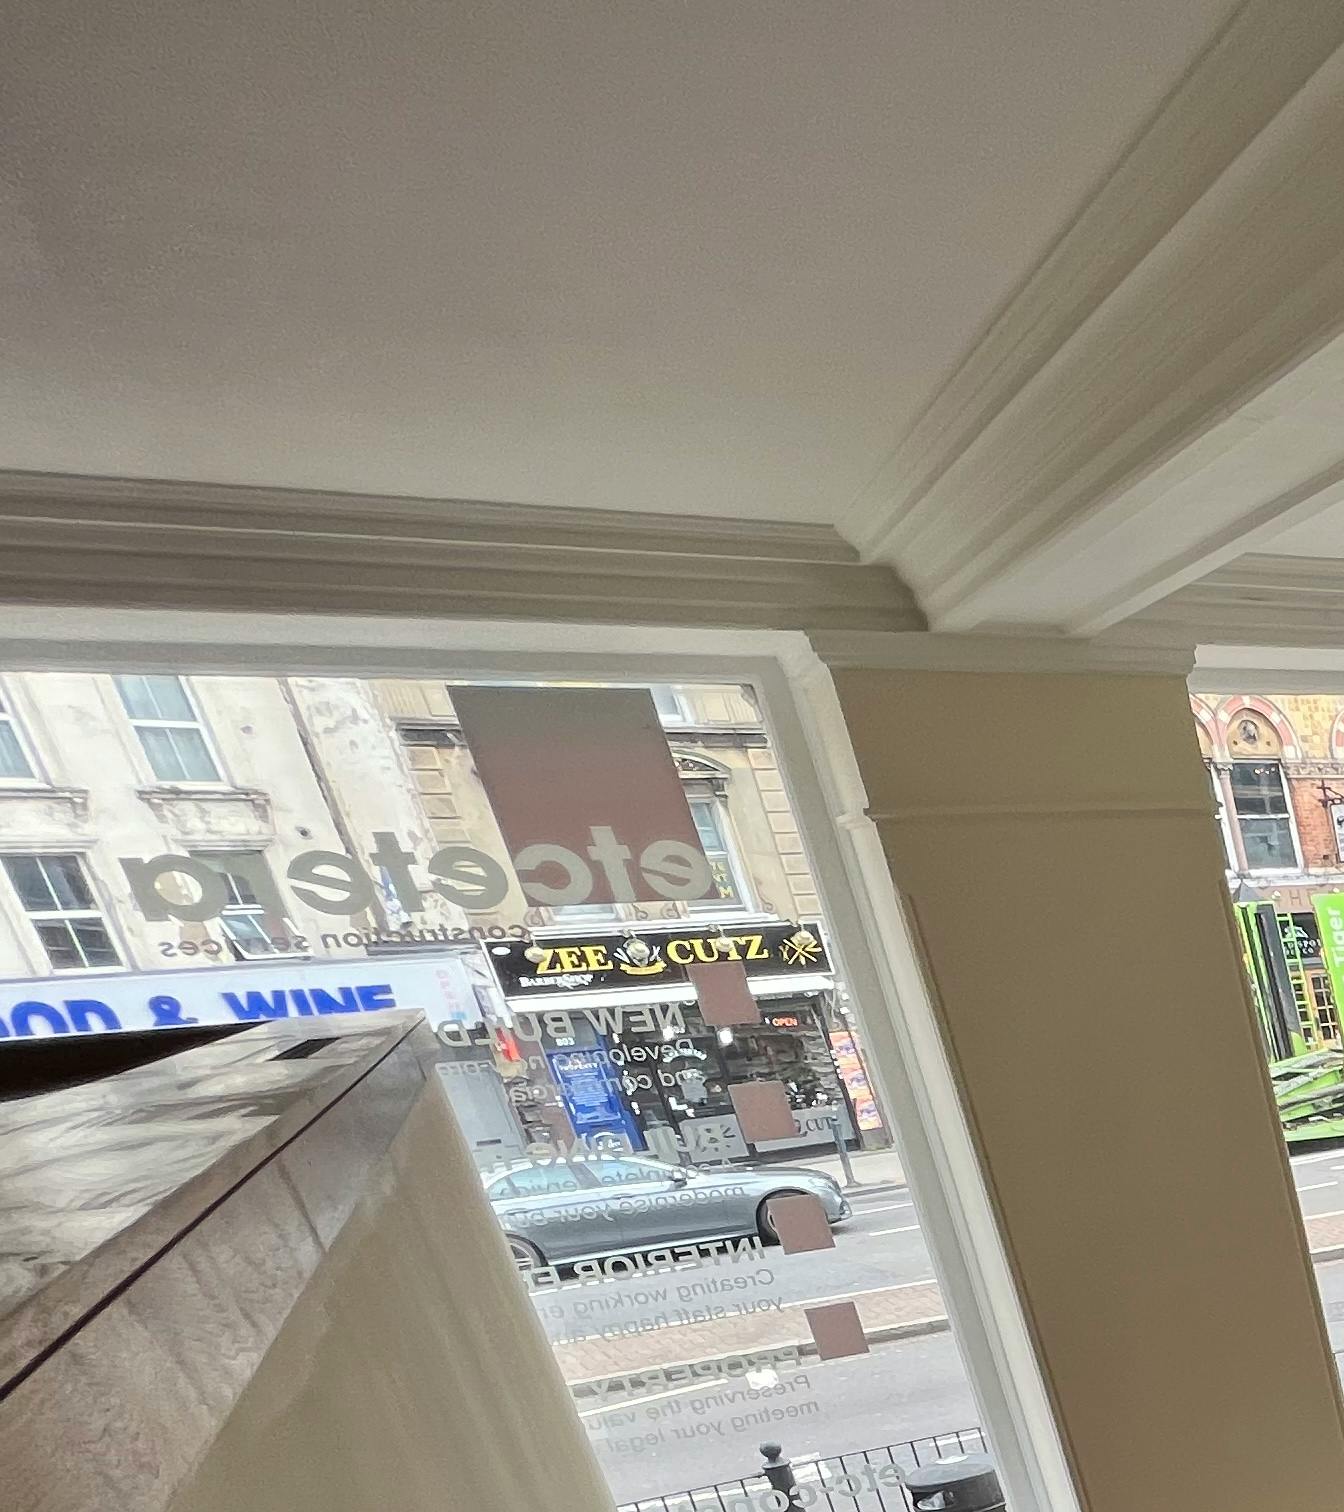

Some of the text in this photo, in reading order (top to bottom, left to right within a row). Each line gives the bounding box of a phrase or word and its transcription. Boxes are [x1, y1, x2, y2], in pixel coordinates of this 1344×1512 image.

[536, 934, 770, 976] ZEE CUTZ
[222, 984, 397, 1022] WINE
[771, 1017, 798, 1027] OPEN
